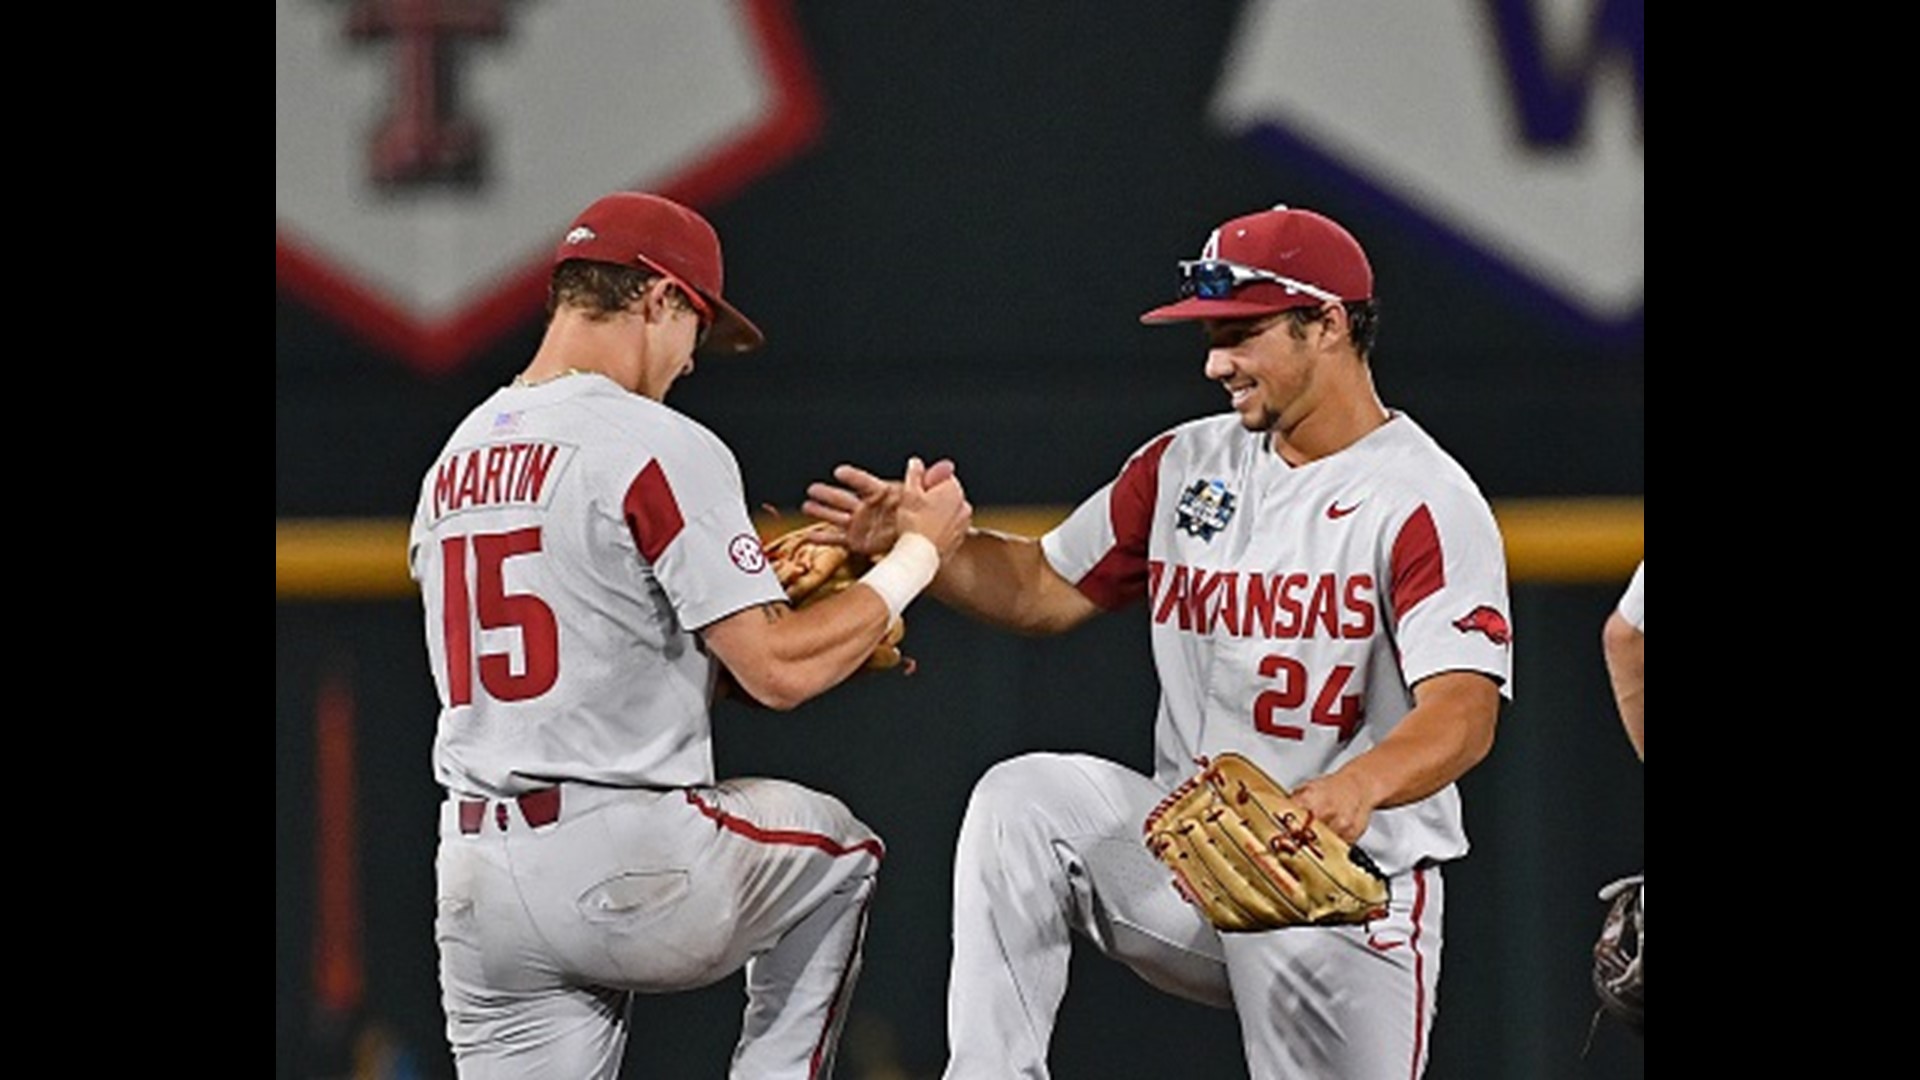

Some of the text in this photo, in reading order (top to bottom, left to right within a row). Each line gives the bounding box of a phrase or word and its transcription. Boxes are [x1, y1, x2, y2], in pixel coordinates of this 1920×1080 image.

[434, 443, 558, 519] MARTIN
[441, 526, 560, 708] 15
[1253, 654, 1364, 742] 24
